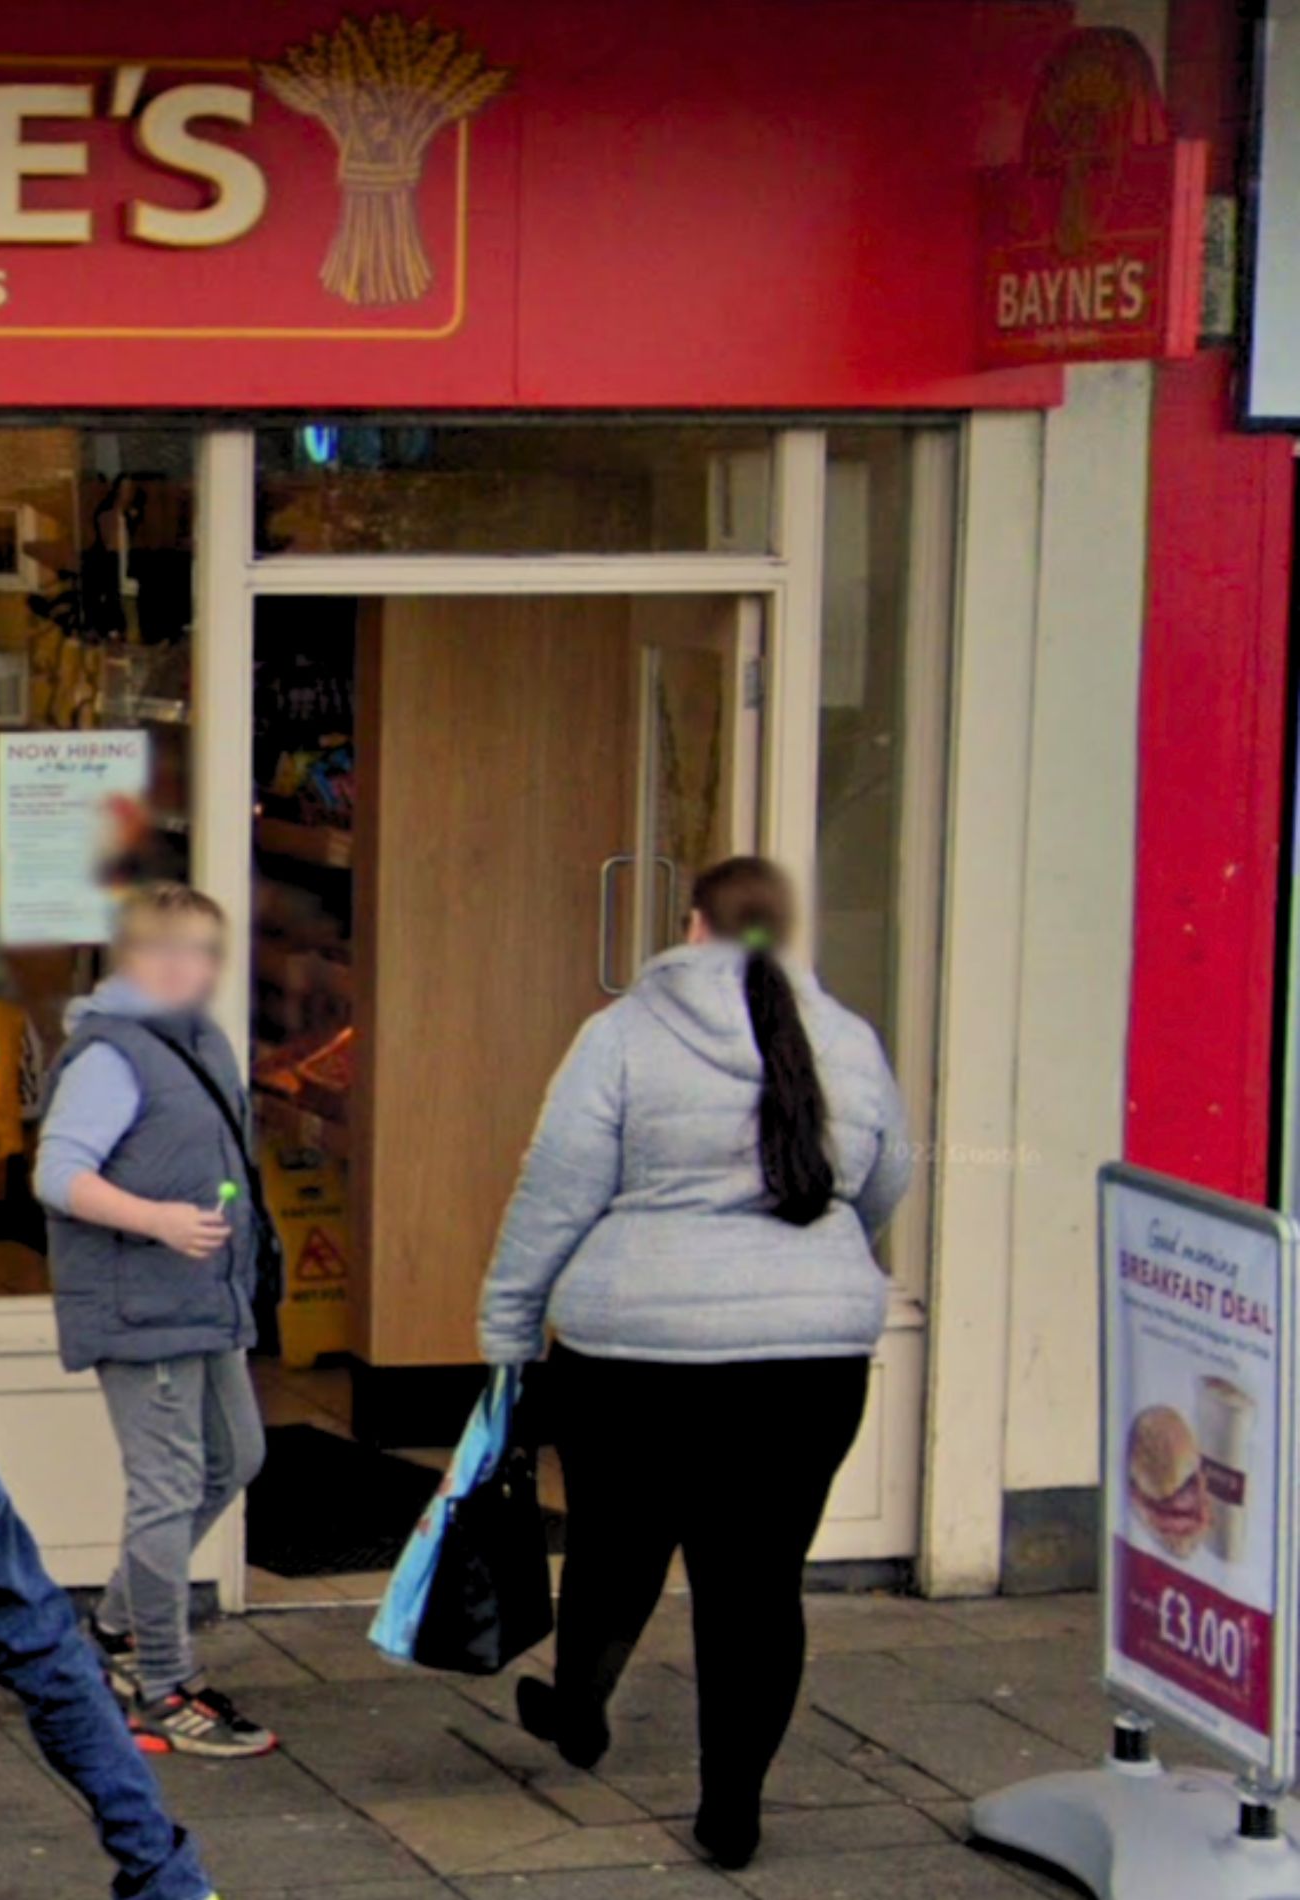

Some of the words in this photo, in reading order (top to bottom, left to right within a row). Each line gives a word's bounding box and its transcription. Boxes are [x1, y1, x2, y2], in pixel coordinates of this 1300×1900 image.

[998, 256, 1146, 328] BAYNE'S
[8, 743, 60, 759] NOW
[66, 742, 138, 759] HIRING
[1119, 1248, 1215, 1312] BREAKFAST
[1219, 1287, 1273, 1336] DEAL
